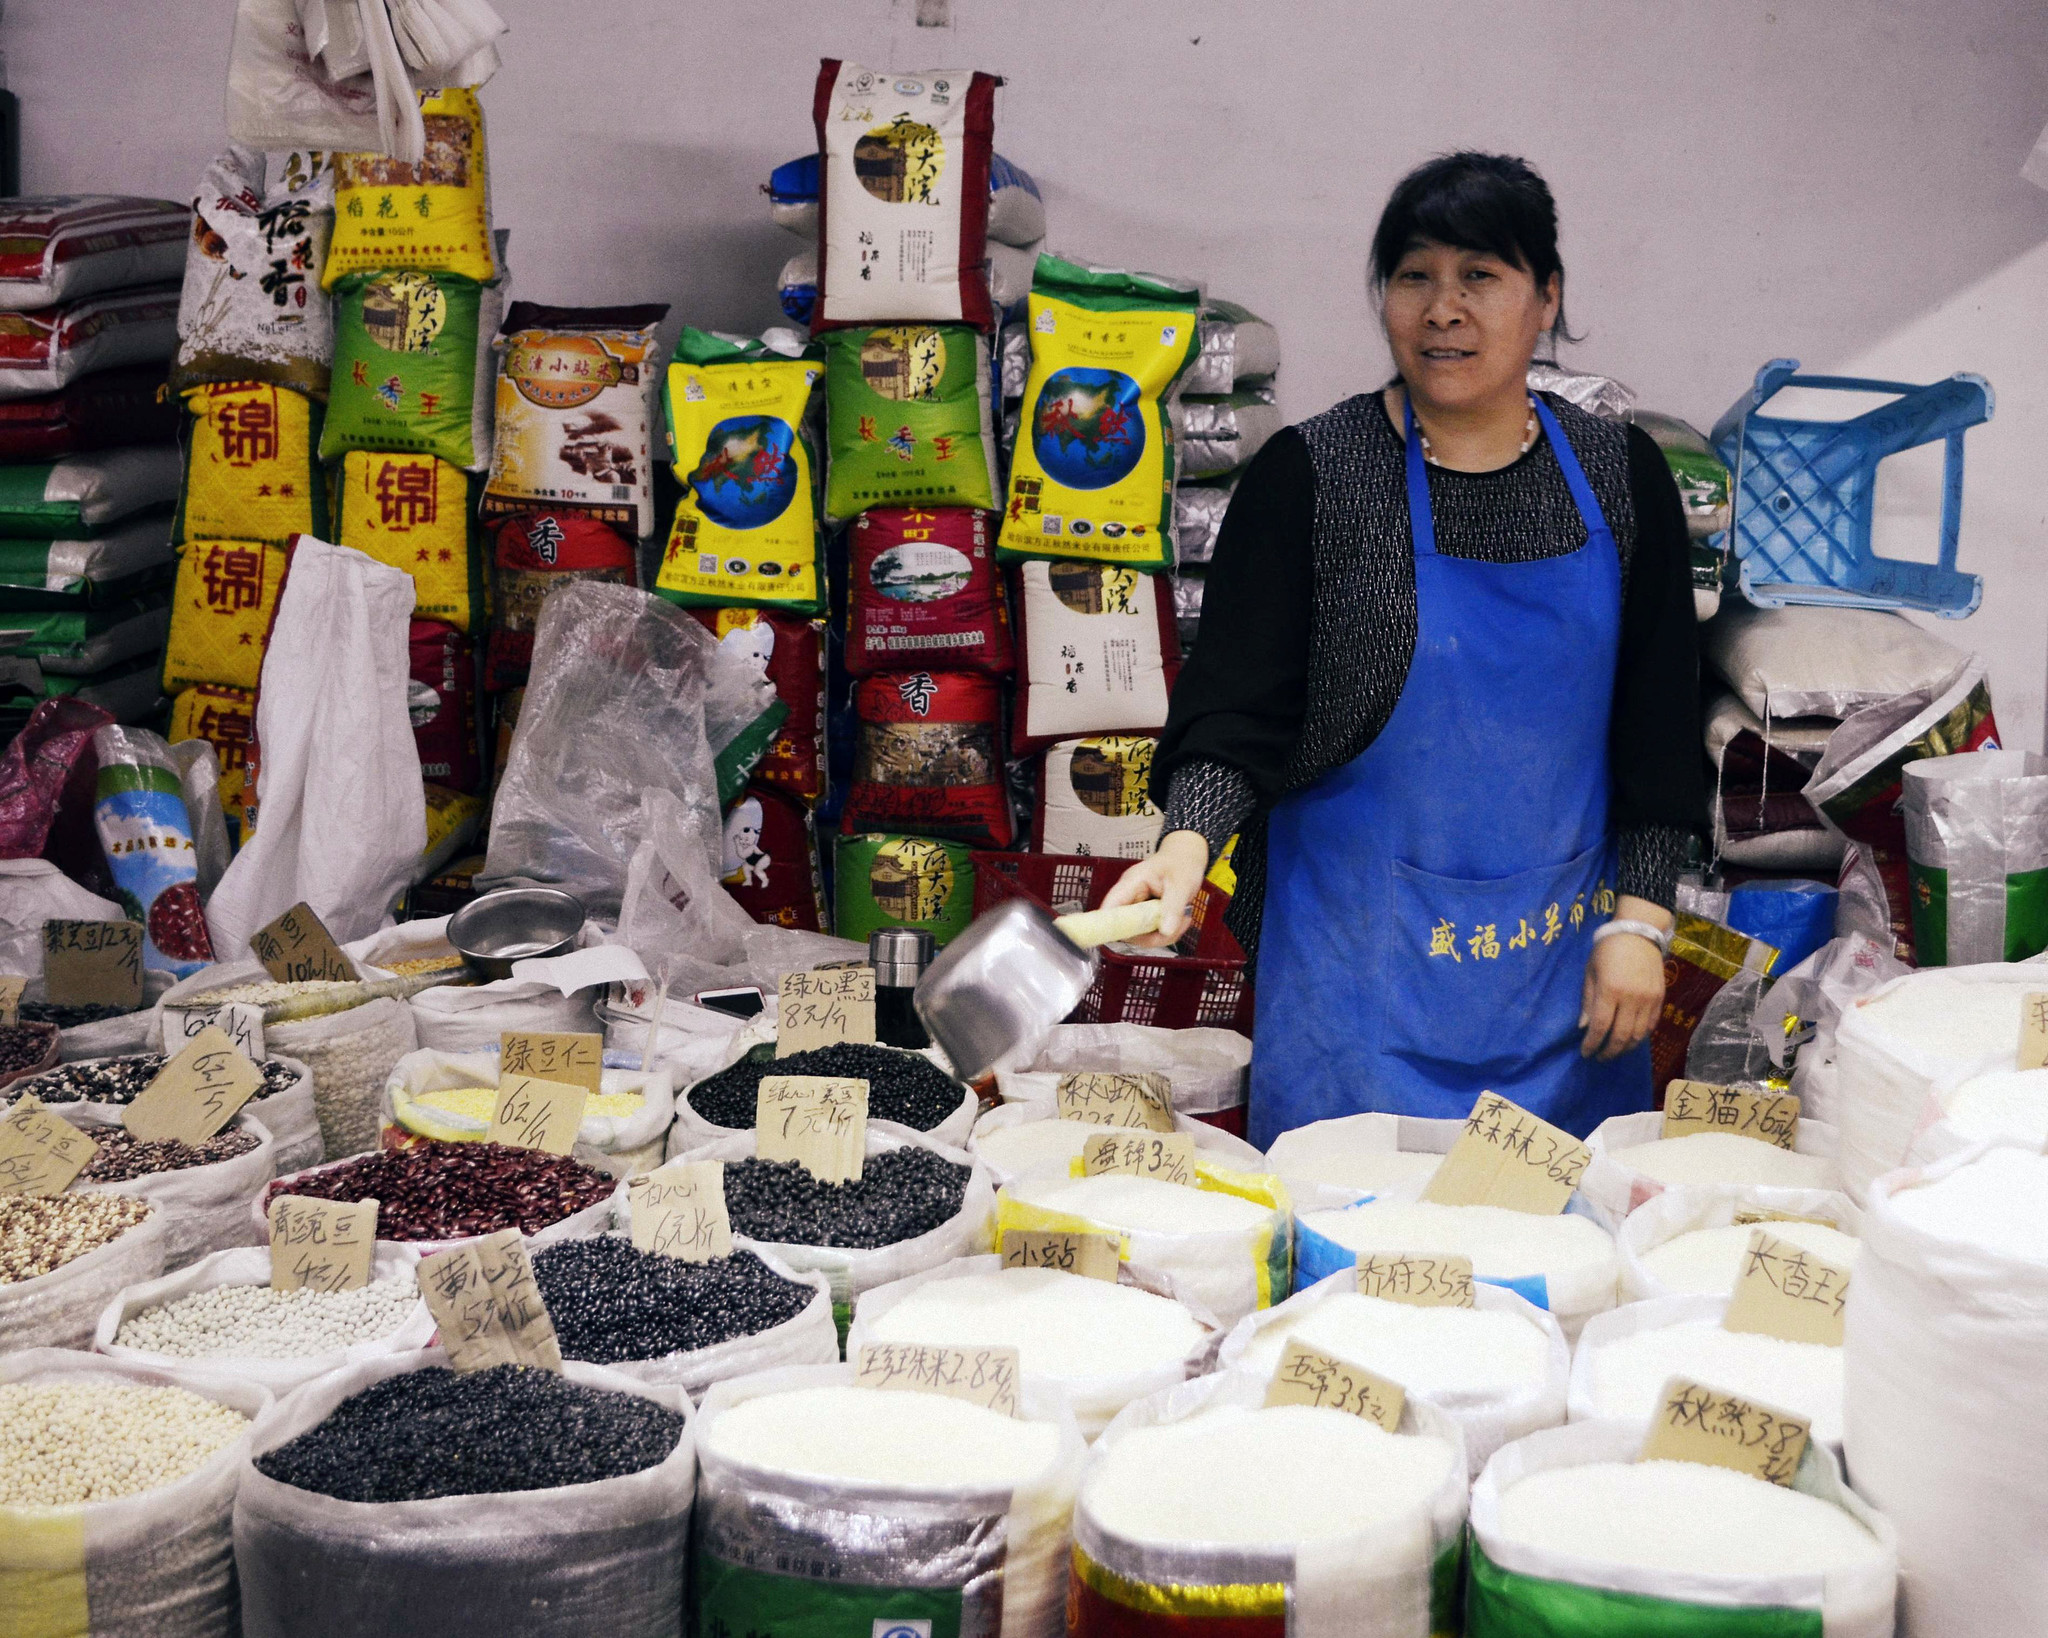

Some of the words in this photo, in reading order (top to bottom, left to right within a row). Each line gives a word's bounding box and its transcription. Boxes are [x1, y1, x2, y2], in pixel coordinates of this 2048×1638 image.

[375, 460, 433, 525] 锦
[528, 516, 565, 565] 香
[203, 545, 257, 609] 锦
[900, 672, 938, 716] 香
[503, 1037, 596, 1074] 绿豆仁
[1010, 1238, 1077, 1268] 小站
